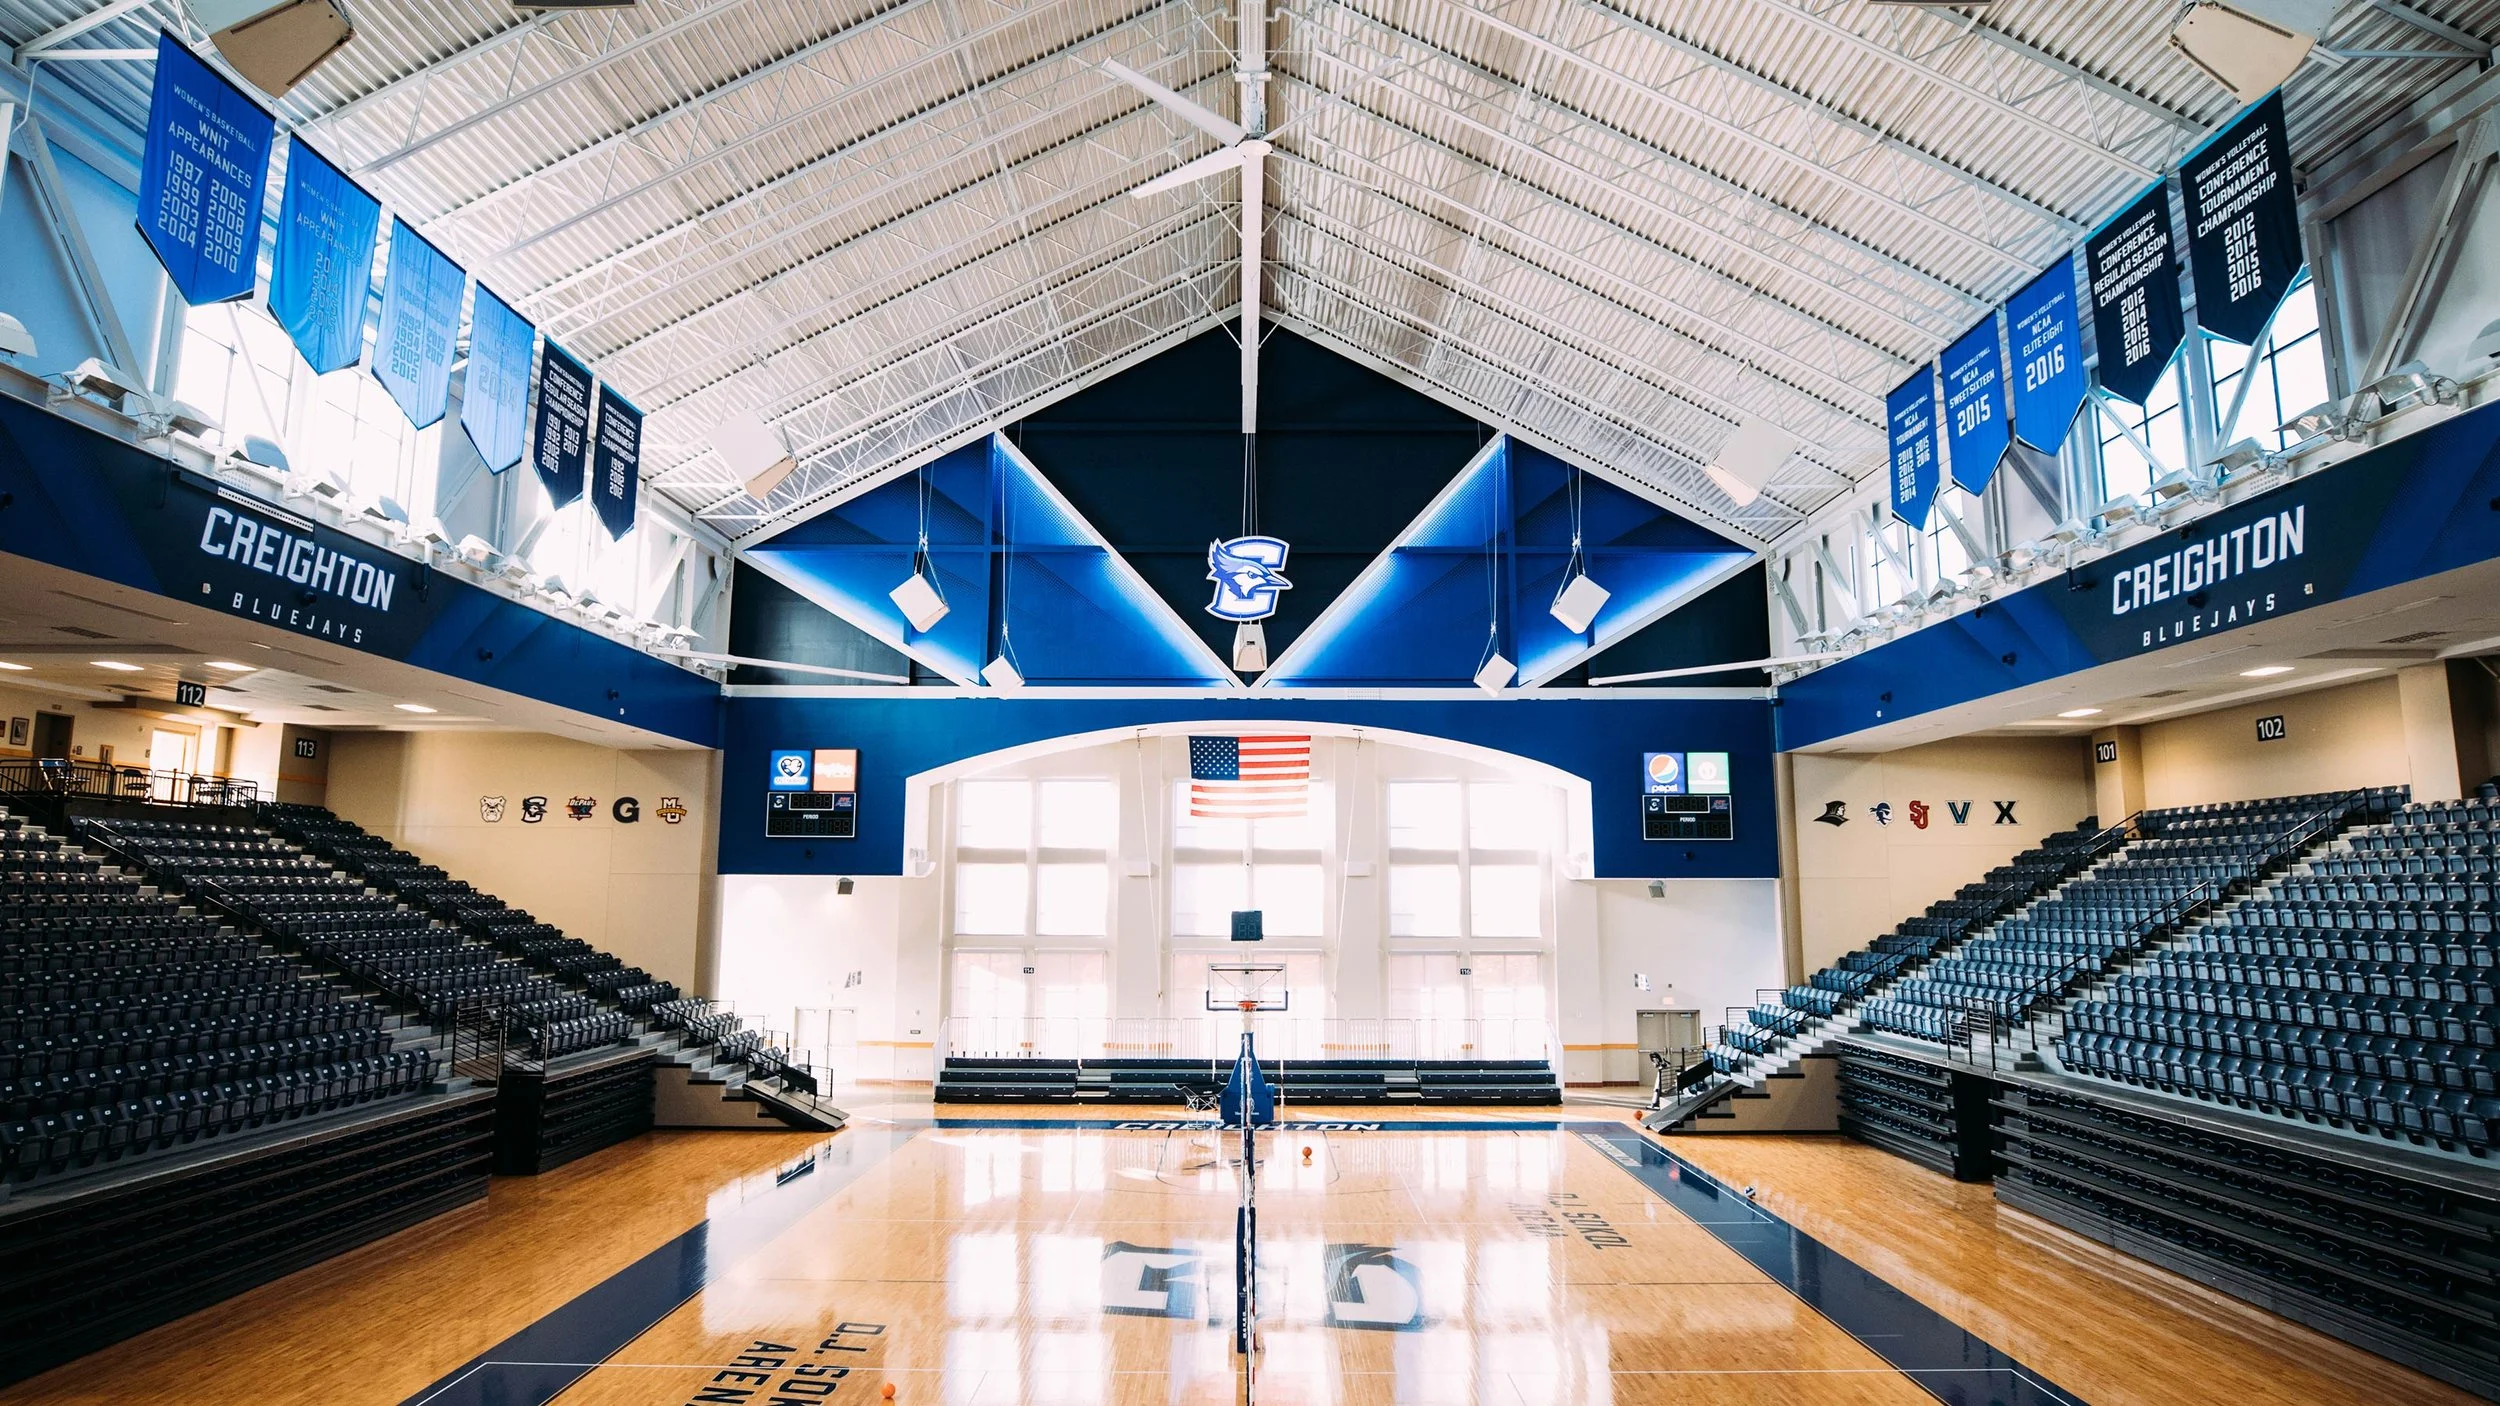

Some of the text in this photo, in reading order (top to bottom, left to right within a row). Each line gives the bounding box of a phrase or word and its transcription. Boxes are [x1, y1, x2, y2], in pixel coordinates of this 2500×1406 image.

[174, 84, 256, 152] WOMEN'S BASKETBALL
[199, 120, 229, 152] WNIT
[2195, 123, 2269, 184] WOMEN'S VOLLEYBALL
[168, 120, 252, 189] APPEARANCES
[170, 150, 203, 185] 1987
[2199, 138, 2268, 201] CONFERENCE
[166, 170, 200, 205] 1999
[210, 179, 247, 217] 2005
[2200, 156, 2270, 218] TOURNAMENT
[162, 190, 199, 228] 2003
[207, 200, 244, 236] 2008
[320, 211, 344, 233] WNIT
[2197, 171, 2277, 239] CHAMPIONSHIP
[157, 210, 197, 249] 2004
[205, 221, 243, 256] 2009
[2097, 209, 2156, 259] WOMEN'S VOLLEYBALL
[2224, 211, 2255, 247] 2012
[204, 242, 238, 274] 2010
[2094, 232, 2167, 295] REGULAR SEASON
[2101, 222, 2156, 274] CONFERENCE
[2226, 230, 2257, 265] 2014
[2099, 252, 2164, 308] CHAMPIONSHIP
[2228, 250, 2259, 284] 2015
[2121, 286, 2145, 316] 2012
[2230, 268, 2262, 303] 2016
[2032, 314, 2052, 336] NCAA
[2122, 303, 2147, 333] 2014
[2124, 320, 2149, 350] 2015
[393, 341, 420, 368] 2002
[396, 325, 420, 351] 1994
[2023, 320, 2063, 357] ELITE EIGHT
[2125, 338, 2151, 367] 2016
[392, 358, 417, 384] 2012
[1962, 366, 1979, 386] NCAA
[2025, 343, 2065, 393] 2016
[1950, 368, 1995, 409] SWEET SIXTEEN
[1957, 393, 1991, 437] 2015
[200, 506, 395, 612] CREIGHTON
[2112, 504, 2305, 616] CREIGHTON
[232, 592, 362, 643] BLUEJAYS
[2142, 593, 2275, 647] BLUEJAYS
[180, 685, 203, 705] 112
[2257, 718, 2284, 739] 102
[297, 740, 315, 757] 113
[2098, 743, 2115, 760] 101
[612, 796, 640, 824] G
[1946, 800, 1973, 826] V
[1993, 800, 2019, 825] X
[814, 1322, 887, 1354] D.J.
